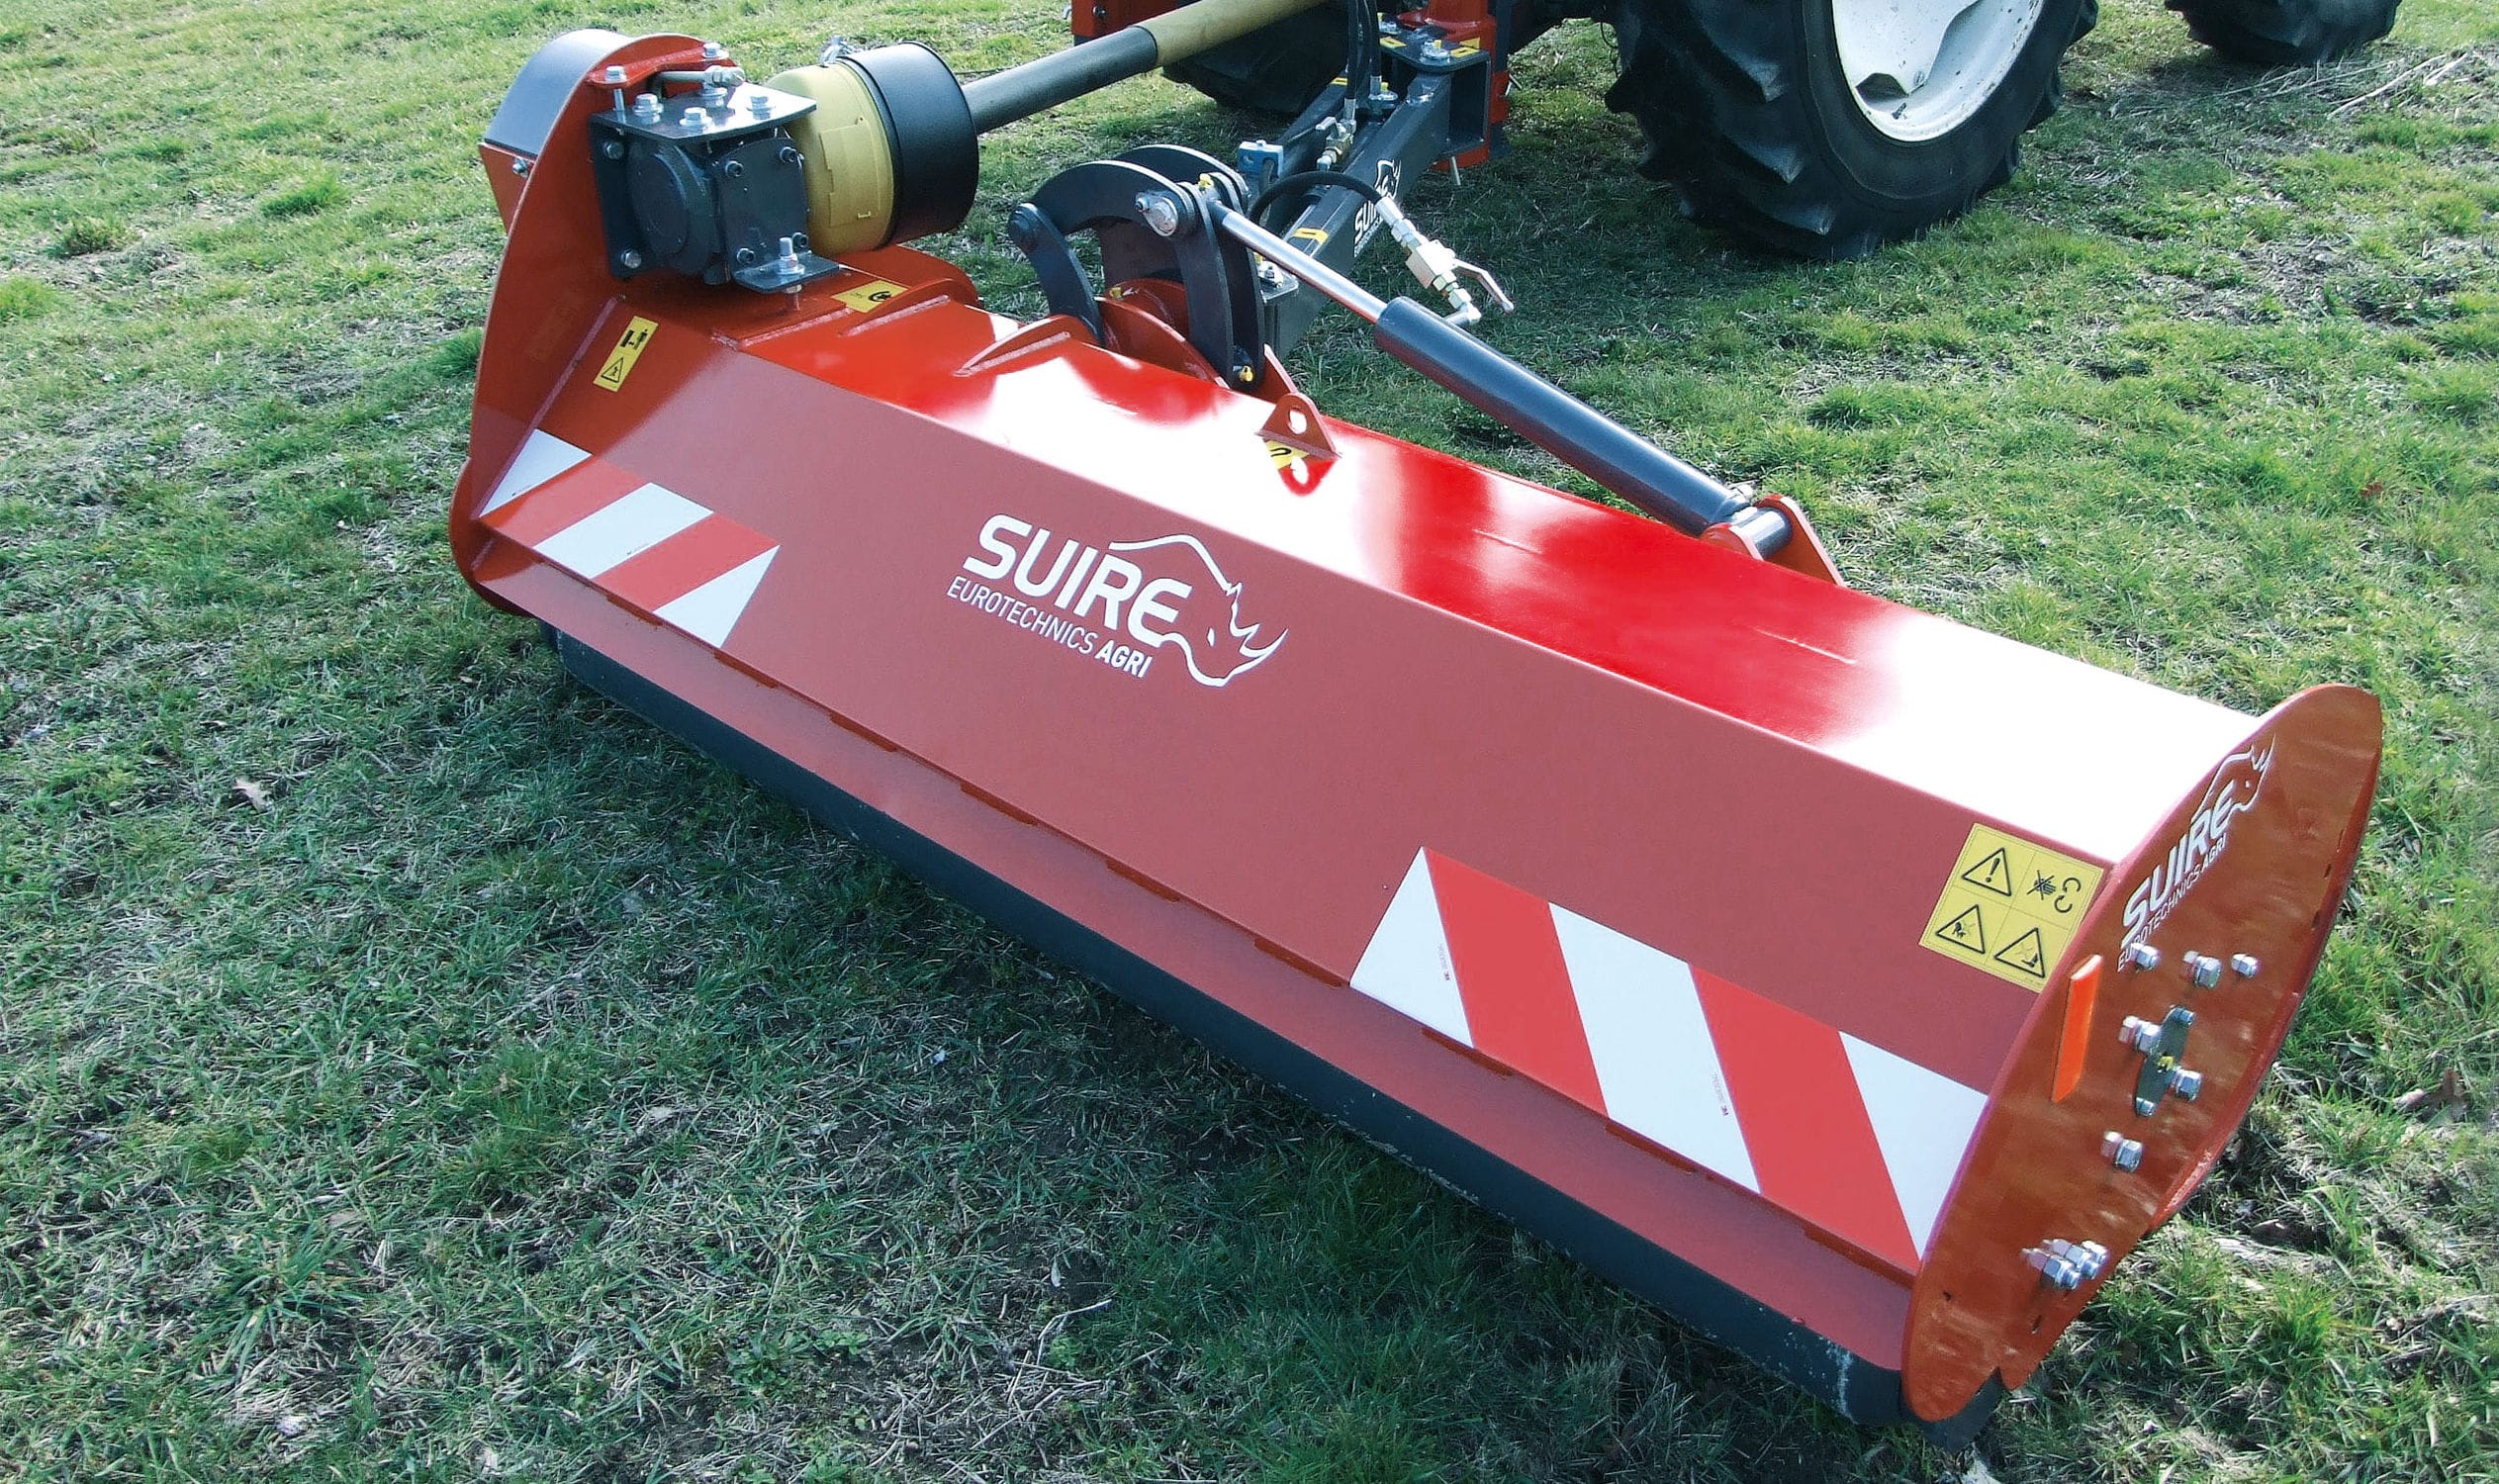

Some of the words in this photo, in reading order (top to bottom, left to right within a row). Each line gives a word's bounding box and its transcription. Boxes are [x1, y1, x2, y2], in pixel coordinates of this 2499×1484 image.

[947, 576, 1098, 654] EUROTECHNICS
[1094, 639, 1154, 679] AGRI
[963, 513, 1193, 648] SUIRE
[2121, 779, 2234, 950] SUIRE
[2201, 832, 2227, 873] AGRI
